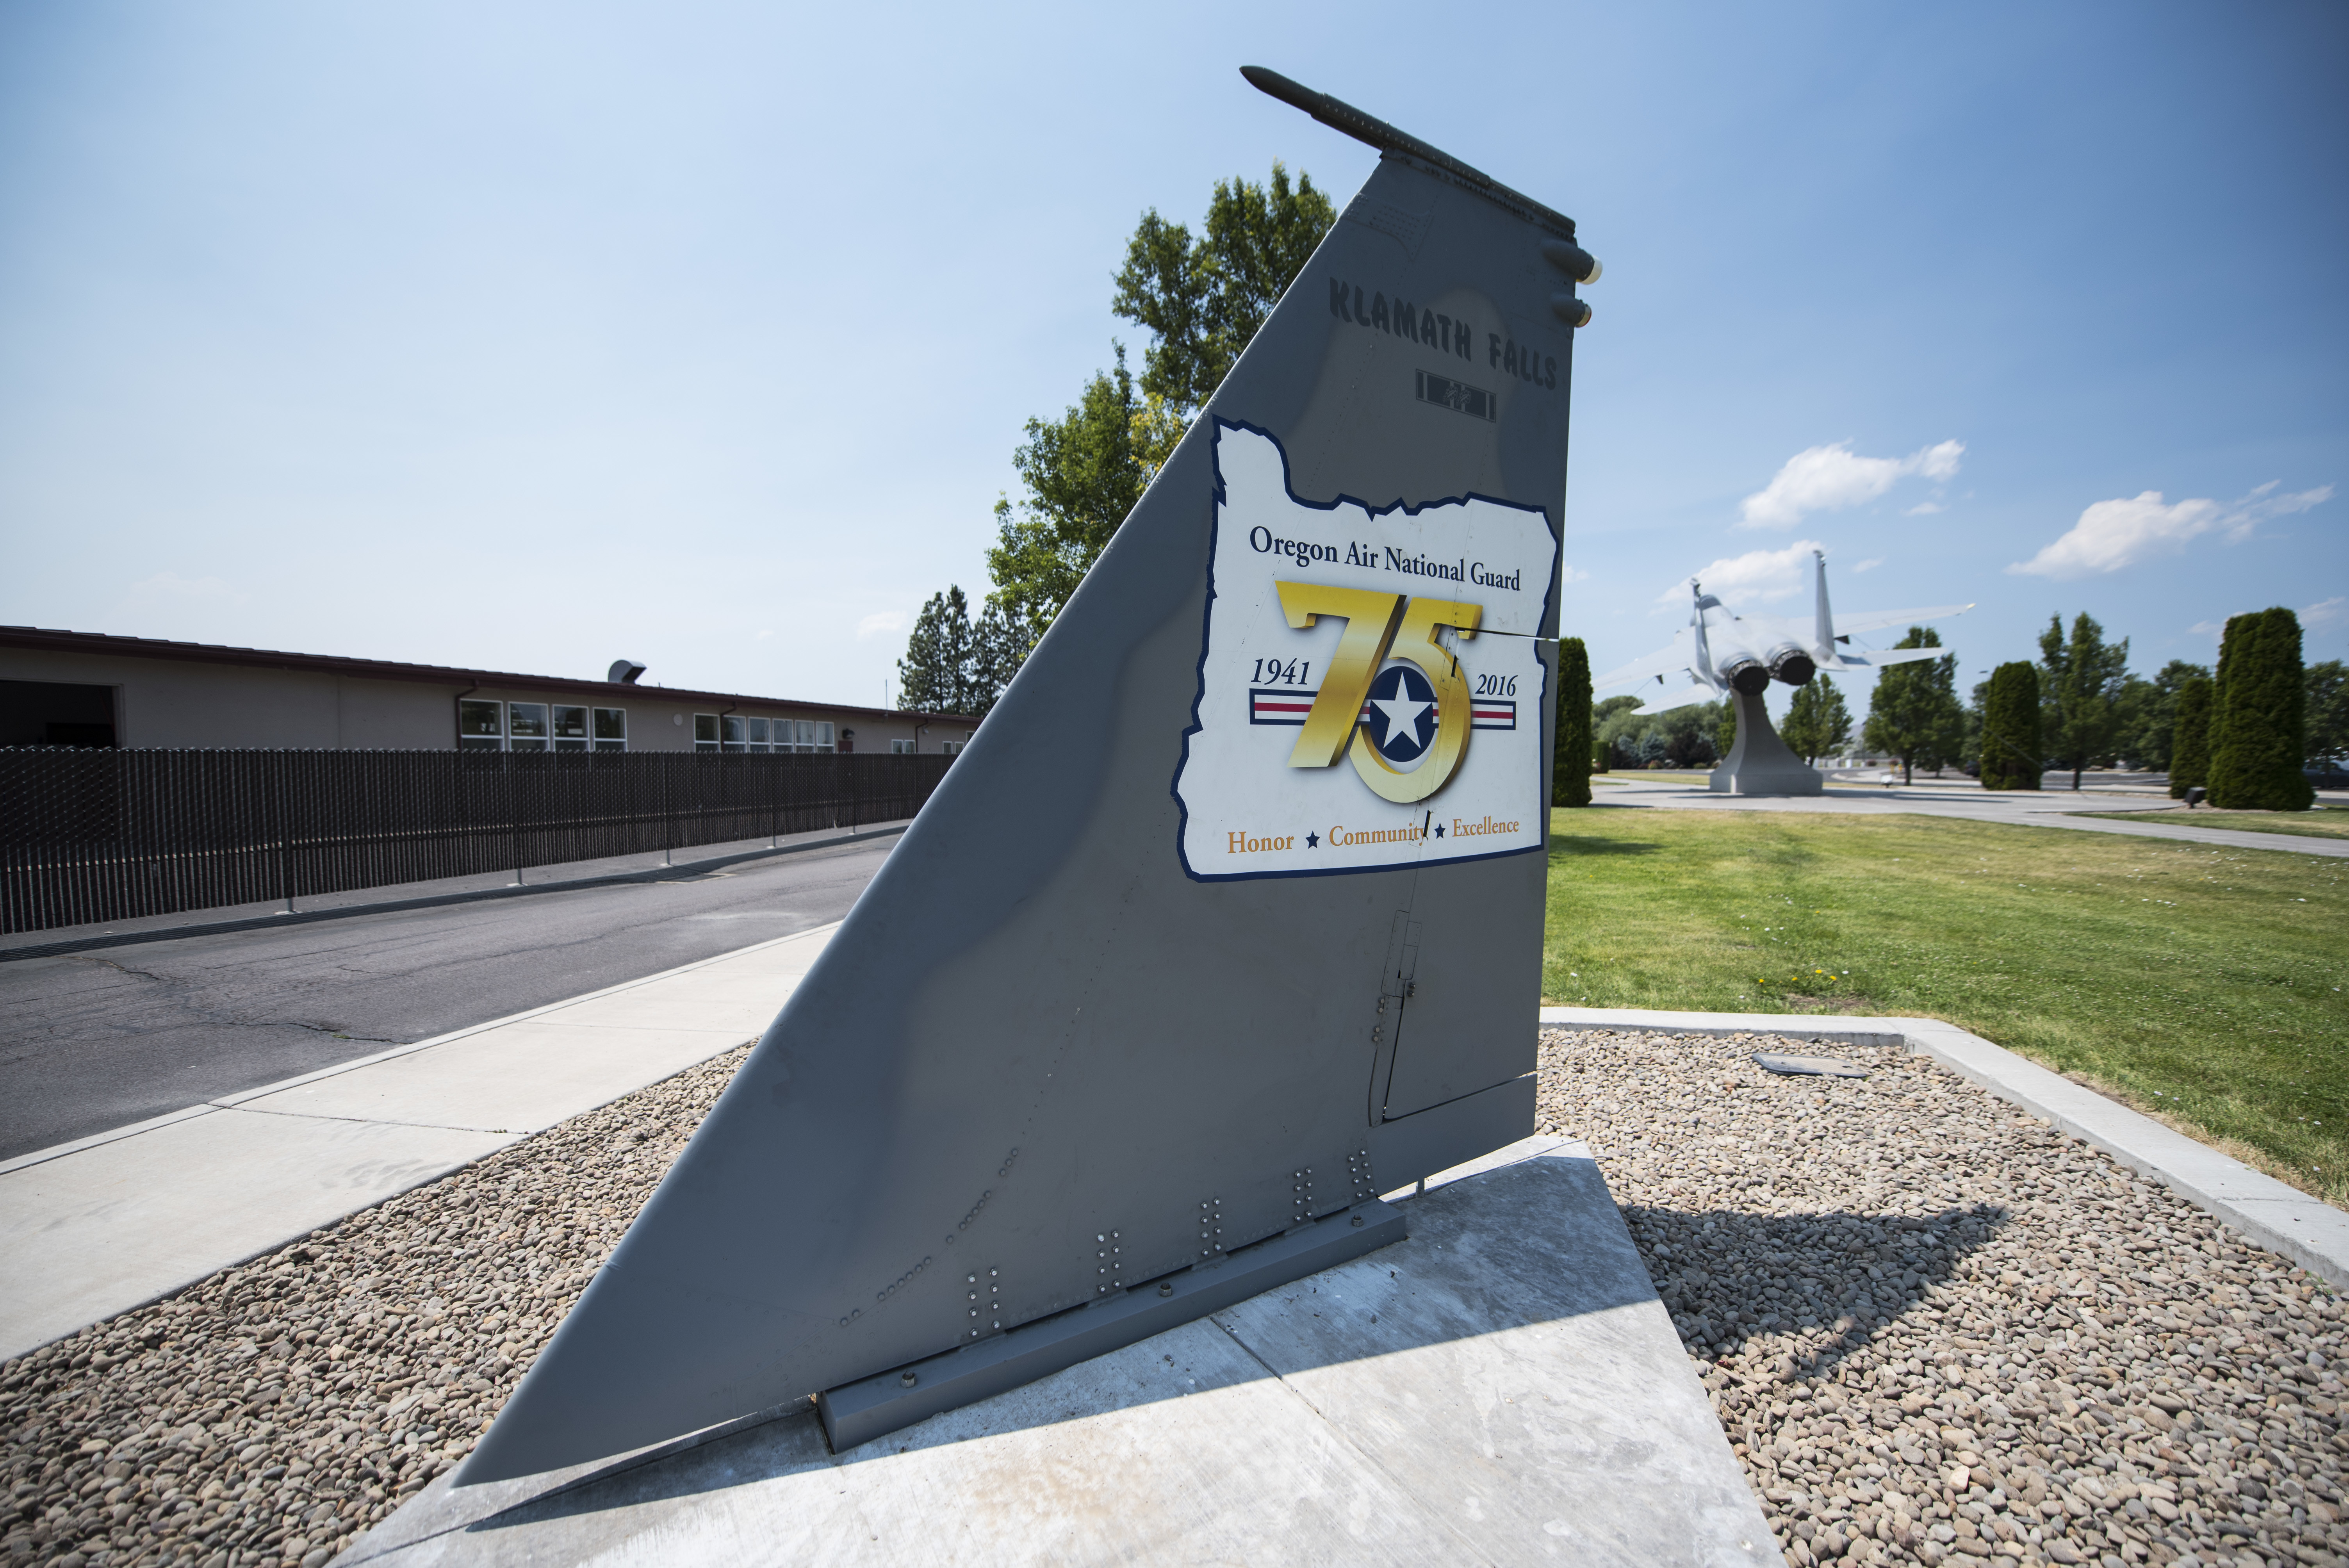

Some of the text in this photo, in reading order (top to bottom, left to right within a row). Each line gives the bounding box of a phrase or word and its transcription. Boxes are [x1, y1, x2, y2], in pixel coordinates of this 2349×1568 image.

[1330, 276, 1557, 390] KLAMATH FALLS
[1250, 526, 1521, 591] Oregon Air National Guard
[1250, 657, 1310, 685] 1941
[1274, 580, 1483, 804] 75
[1475, 674, 1518, 697] 2016
[1227, 815, 1519, 853] Honor Community Excellence
